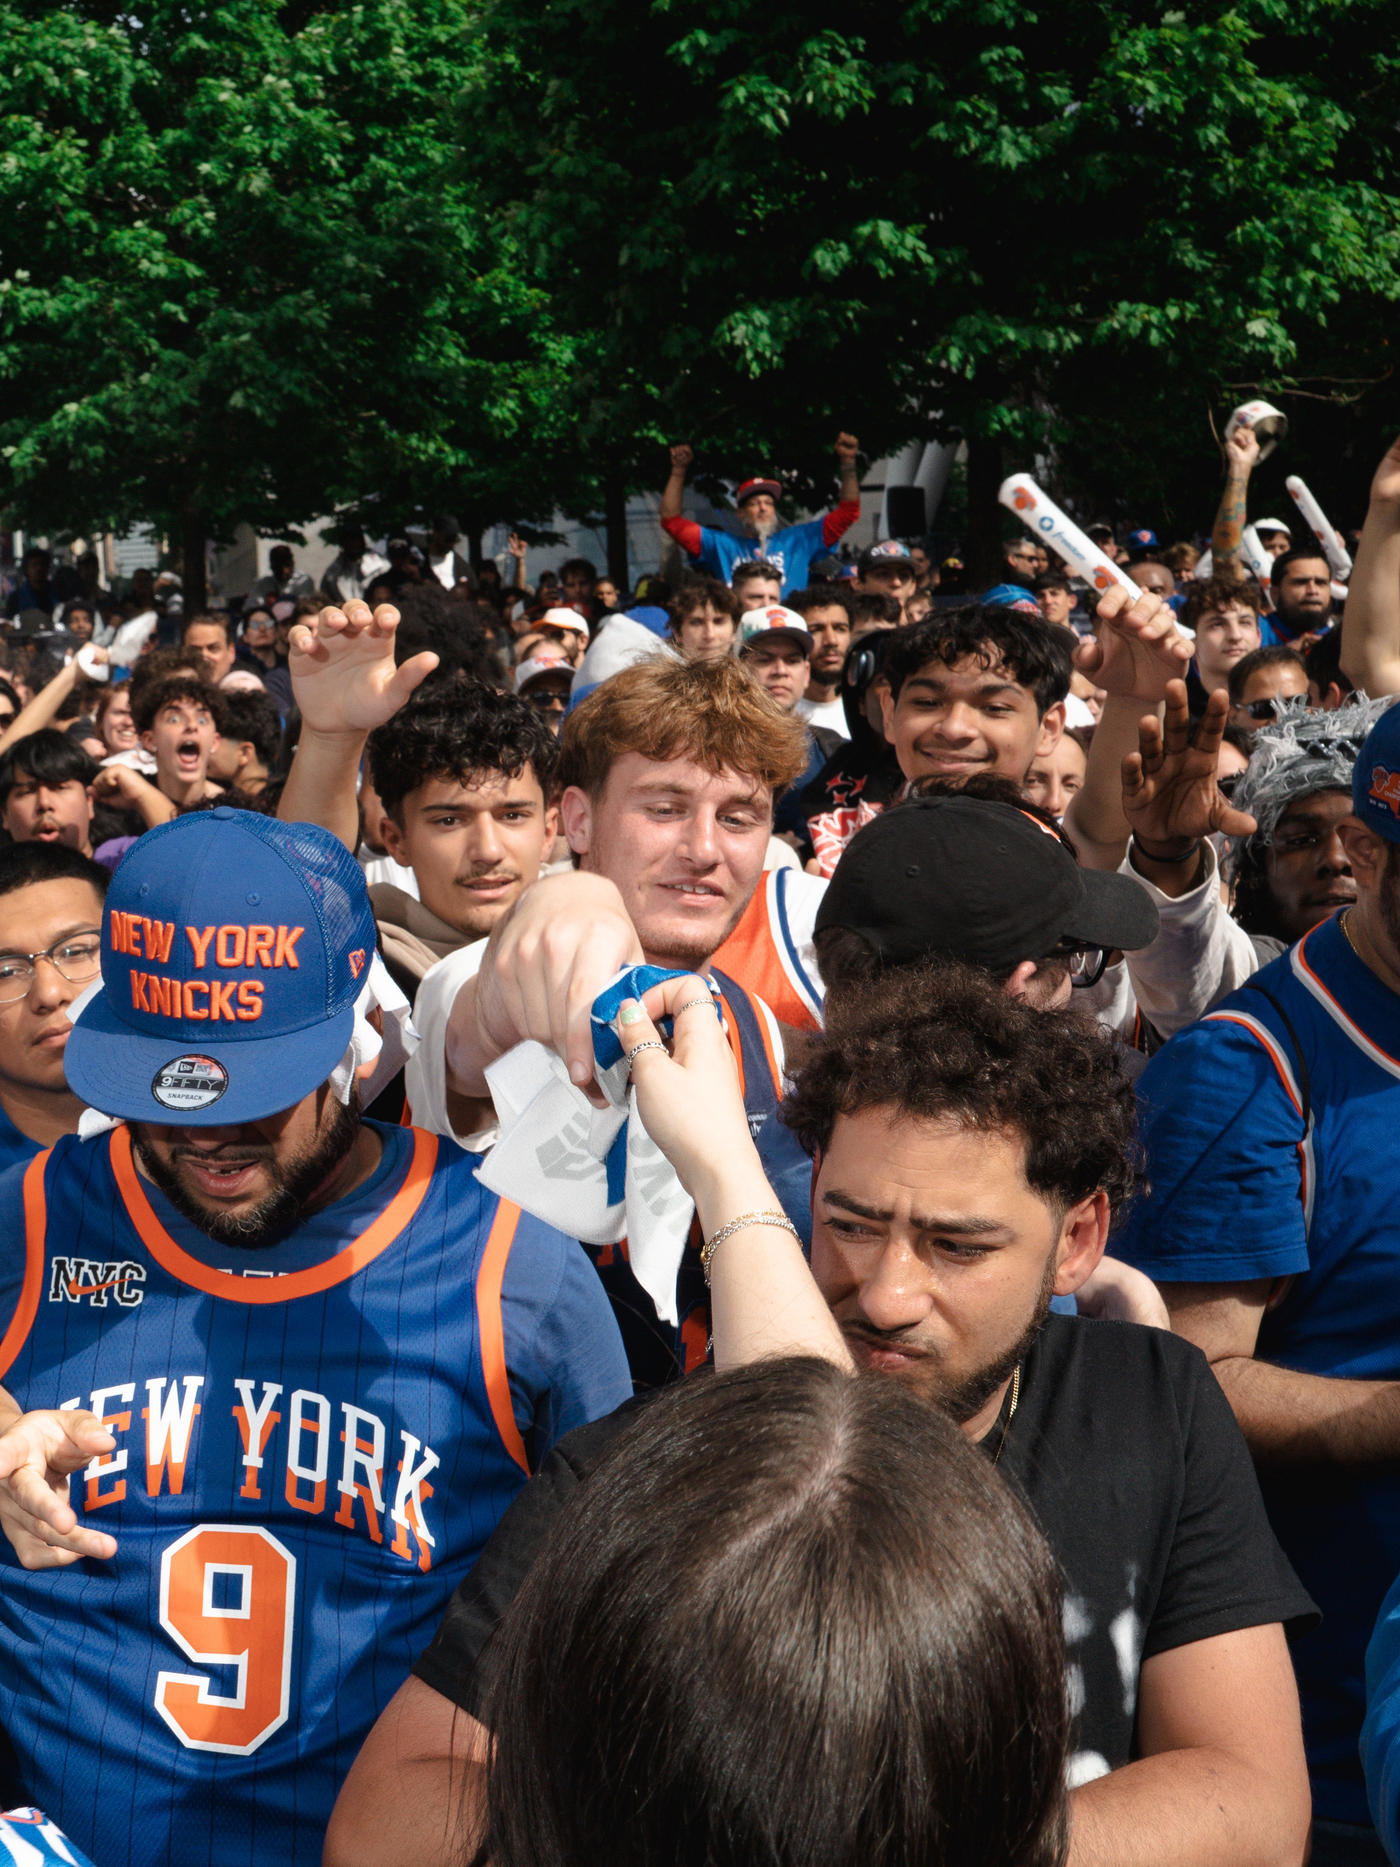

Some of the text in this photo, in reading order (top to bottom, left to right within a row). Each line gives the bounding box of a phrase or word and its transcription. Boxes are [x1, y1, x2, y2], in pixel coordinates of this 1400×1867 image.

[110, 910, 304, 969] NEW YORK
[130, 969, 265, 1021] KNICKS
[49, 1256, 147, 1307] NYC
[58, 1376, 441, 1574] EW YORK
[154, 1523, 297, 1757] 9
